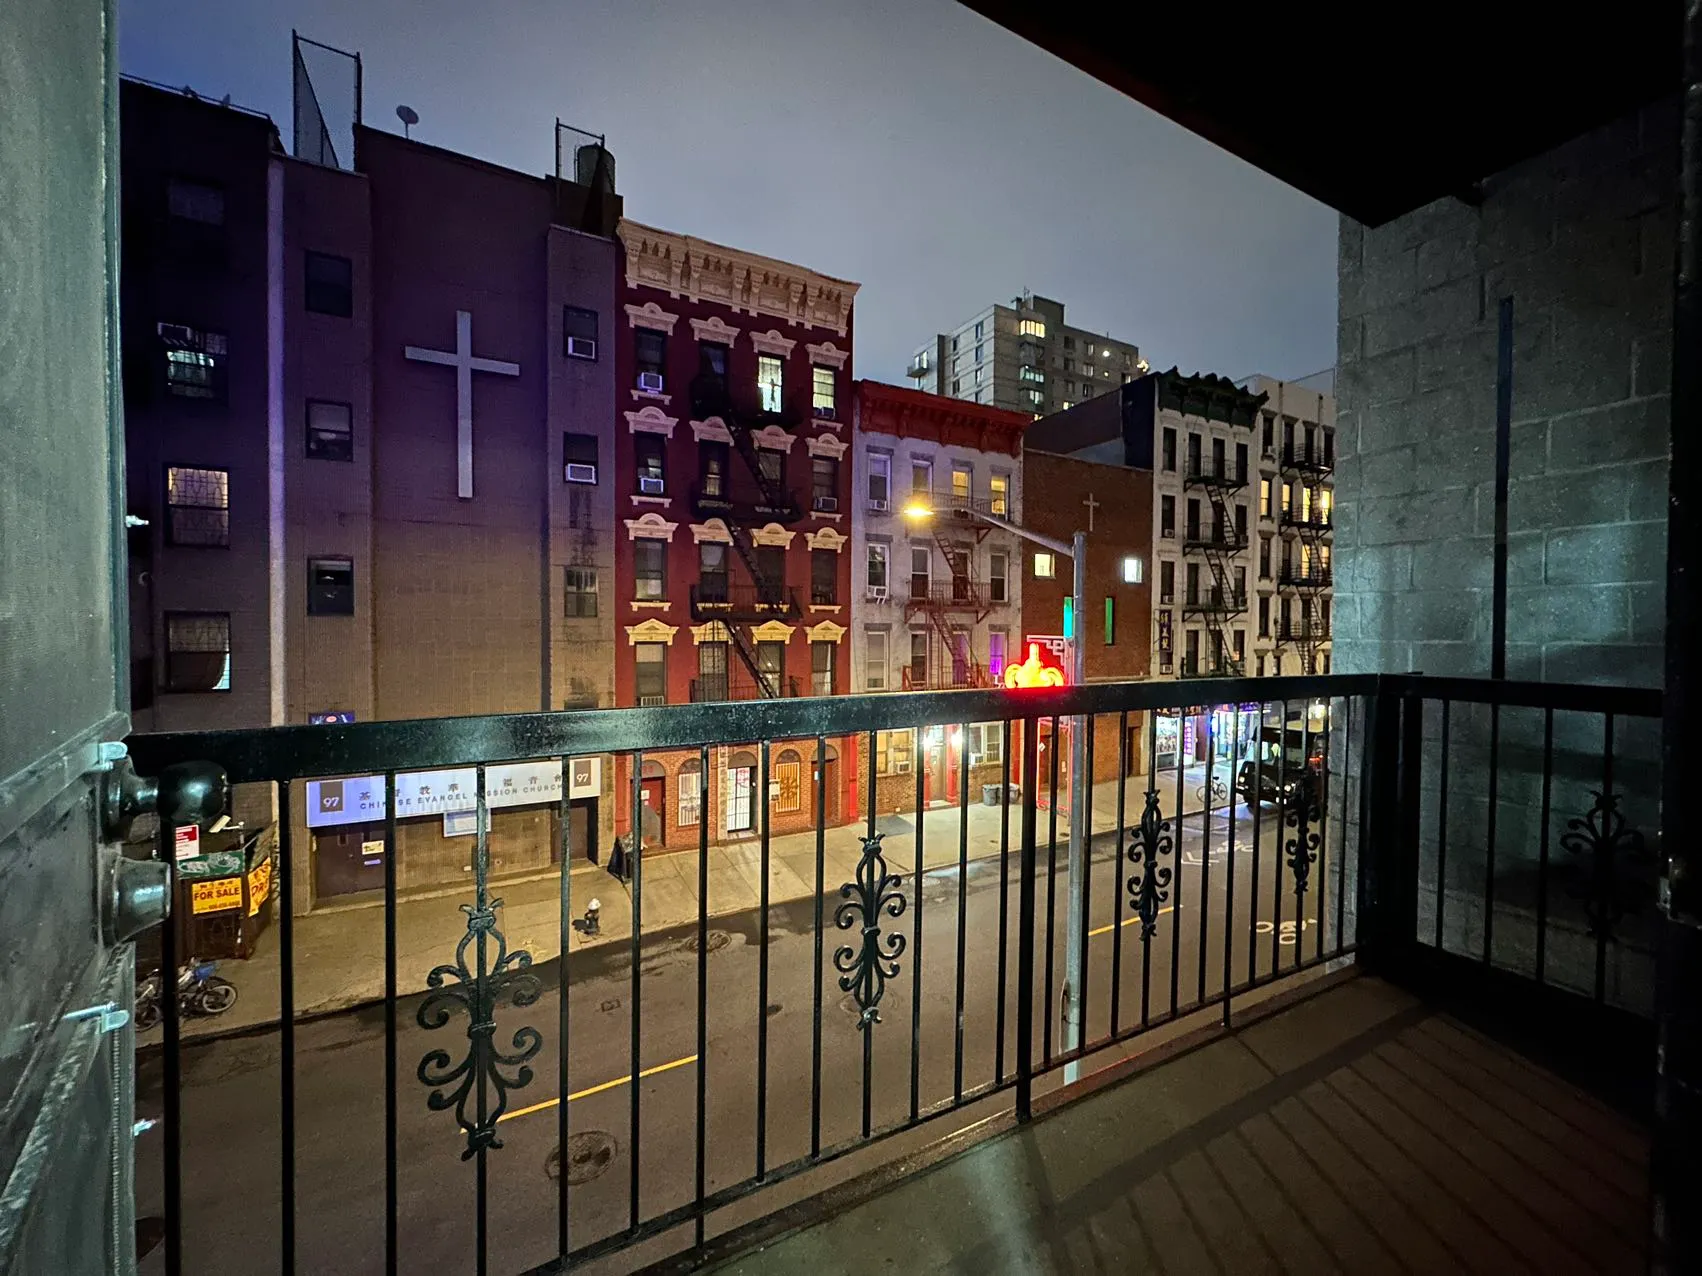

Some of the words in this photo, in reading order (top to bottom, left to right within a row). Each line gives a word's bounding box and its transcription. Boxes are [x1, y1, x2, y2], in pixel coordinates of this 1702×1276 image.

[576, 772, 589, 783] 97
[323, 796, 340, 808] 97
[359, 798, 412, 810] CHISE
[417, 792, 468, 804] EVANGEL
[473, 786, 518, 799] SSION
[523, 783, 563, 794] CHURCH
[194, 890, 214, 901] FOR
[216, 886, 240, 898] SALE
